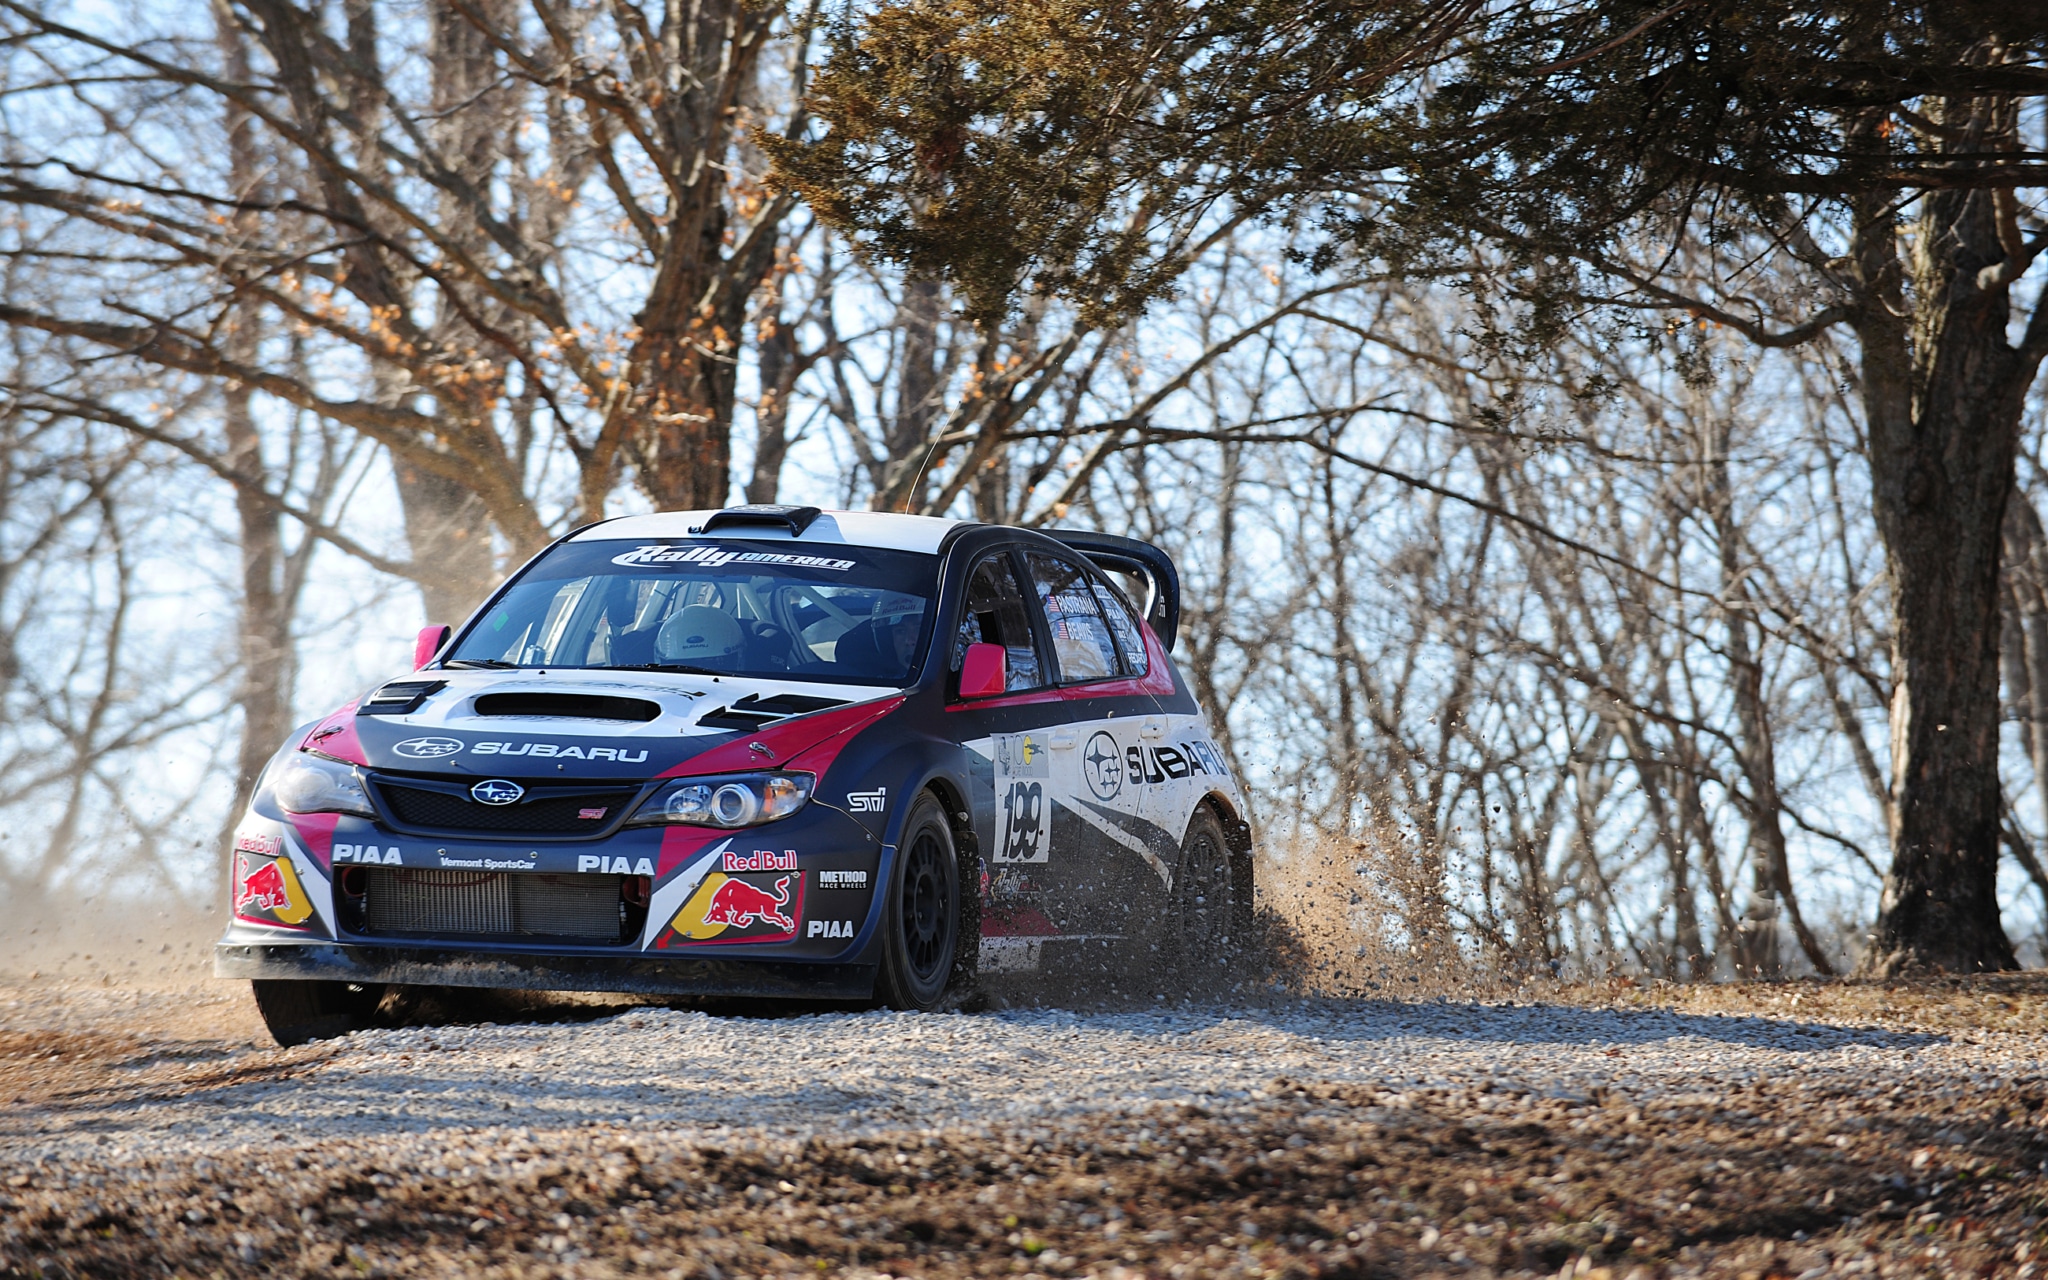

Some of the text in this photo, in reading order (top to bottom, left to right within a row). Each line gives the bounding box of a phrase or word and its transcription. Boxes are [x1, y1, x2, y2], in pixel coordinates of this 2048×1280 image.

[622, 545, 857, 570] Rally AMERICA
[1055, 595, 1097, 614] PASTRANA
[470, 741, 649, 763] SUBARU
[1126, 741, 1228, 785] SUBARU
[1002, 781, 1043, 860] 199
[332, 843, 403, 865] PIAA
[440, 857, 536, 870] Vermont SportsCar
[577, 854, 656, 875] PIAA
[723, 850, 798, 871] Red Bull
[819, 871, 867, 883] METHOD
[807, 920, 854, 938] PIAA
